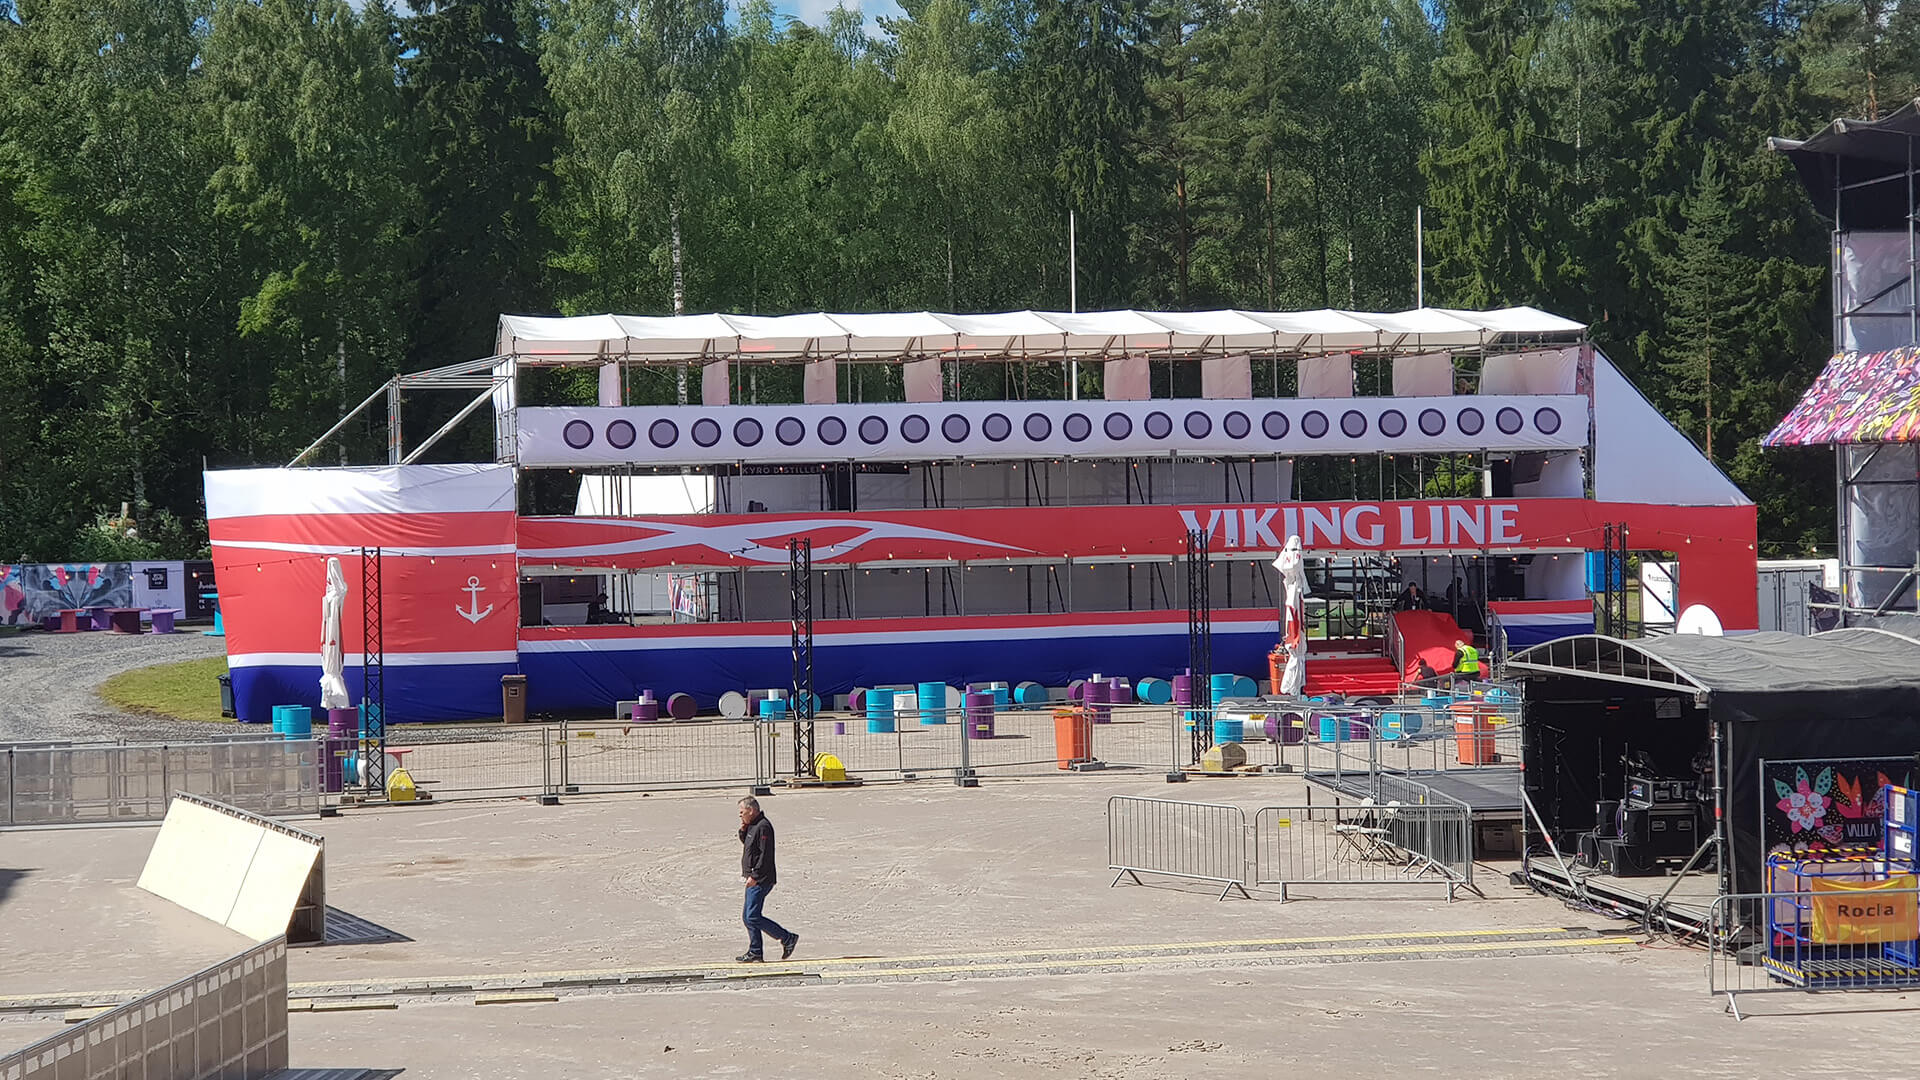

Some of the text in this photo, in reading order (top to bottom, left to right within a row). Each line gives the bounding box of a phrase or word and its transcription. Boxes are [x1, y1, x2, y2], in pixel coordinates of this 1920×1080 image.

[774, 464, 832, 474] DSTILLE
[833, 464, 882, 473] OMPANY
[1178, 504, 1522, 549] VIKING LINE
[1838, 903, 1894, 917] Rocla
